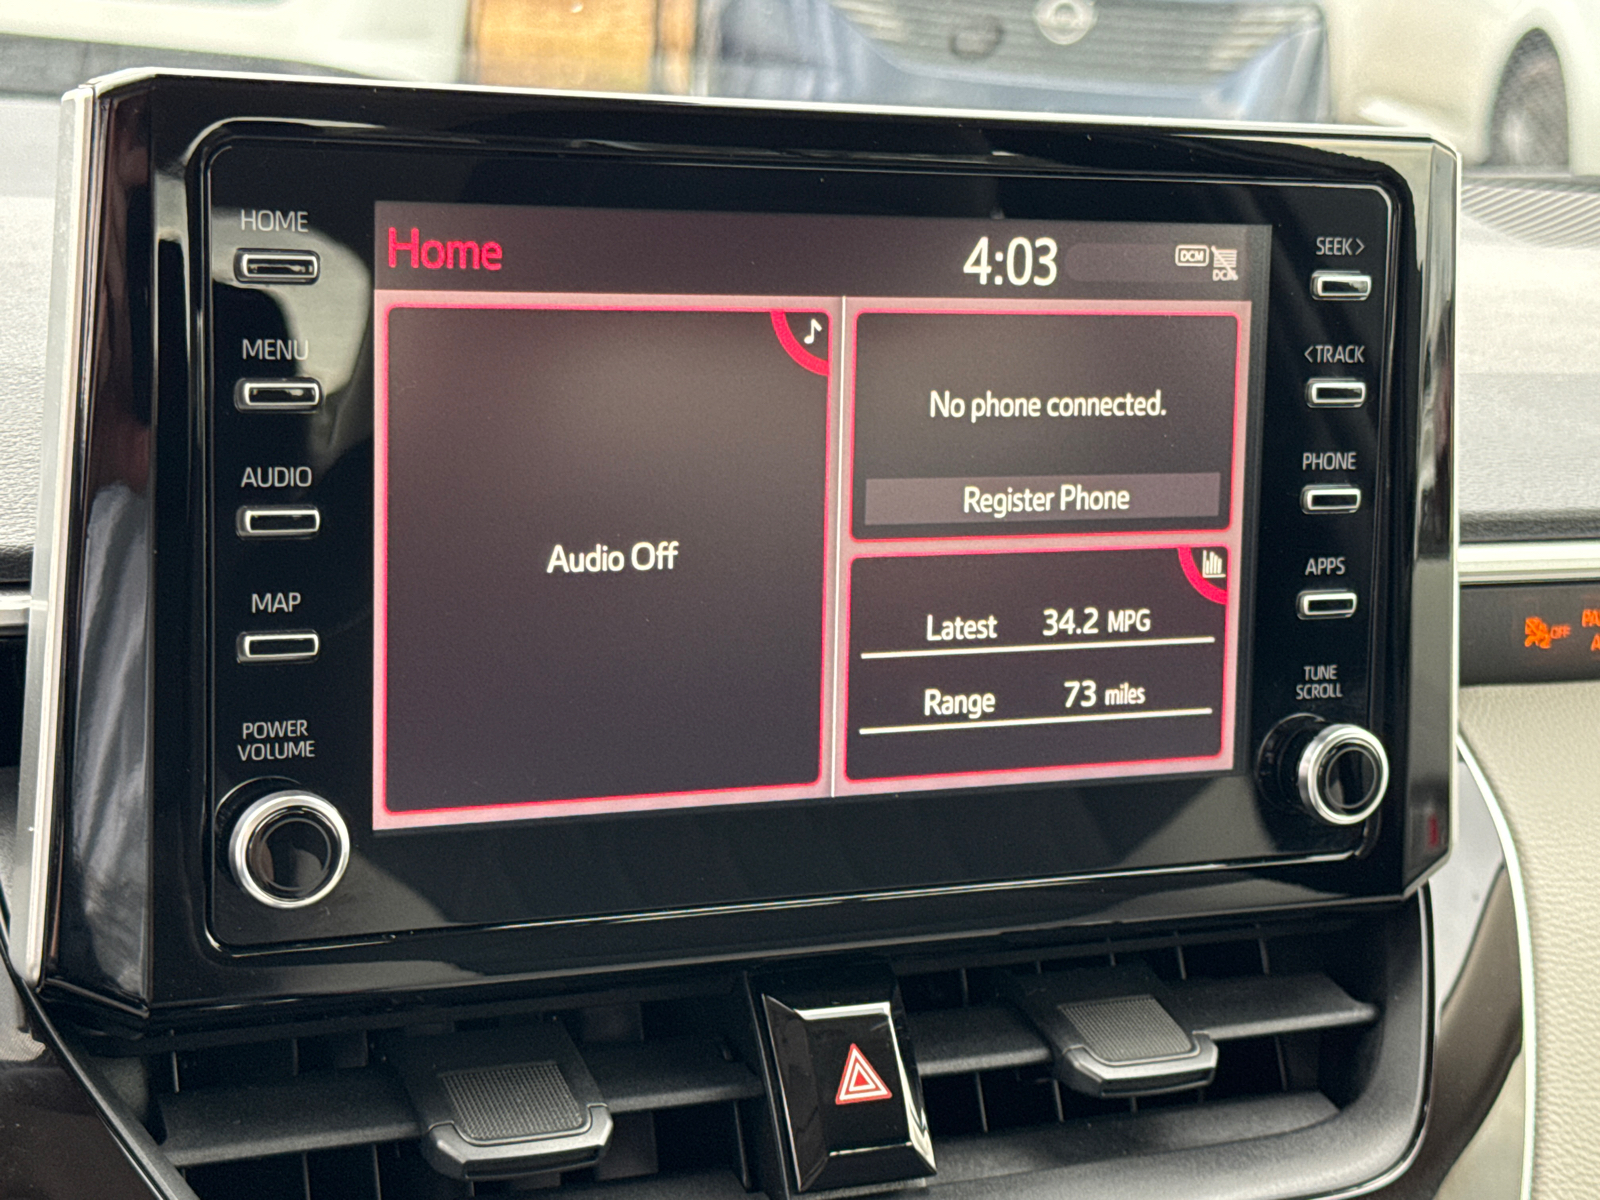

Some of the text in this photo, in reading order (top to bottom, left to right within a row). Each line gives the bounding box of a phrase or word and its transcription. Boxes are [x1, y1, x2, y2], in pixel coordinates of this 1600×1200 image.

[241, 209, 309, 232] HOME
[388, 227, 502, 270] Home
[1180, 250, 1204, 262] DCM
[963, 237, 1057, 286] 4:03
[242, 338, 309, 360] MENU
[930, 389, 1166, 423] No phone connected.
[1303, 452, 1356, 470] PHONE
[241, 467, 312, 487] AUDIO
[963, 484, 1129, 519] Register Phone
[547, 541, 679, 573] Audio Off
[1305, 557, 1345, 575] APPS
[252, 593, 300, 613] MAP
[927, 607, 1150, 641] Latest 34.2 MPG
[1303, 664, 1338, 681] TUNE
[924, 680, 1145, 719] Range 73 miles
[1295, 682, 1343, 700] SCROLL
[242, 719, 309, 740] POWER
[237, 740, 316, 761] VOLUME
